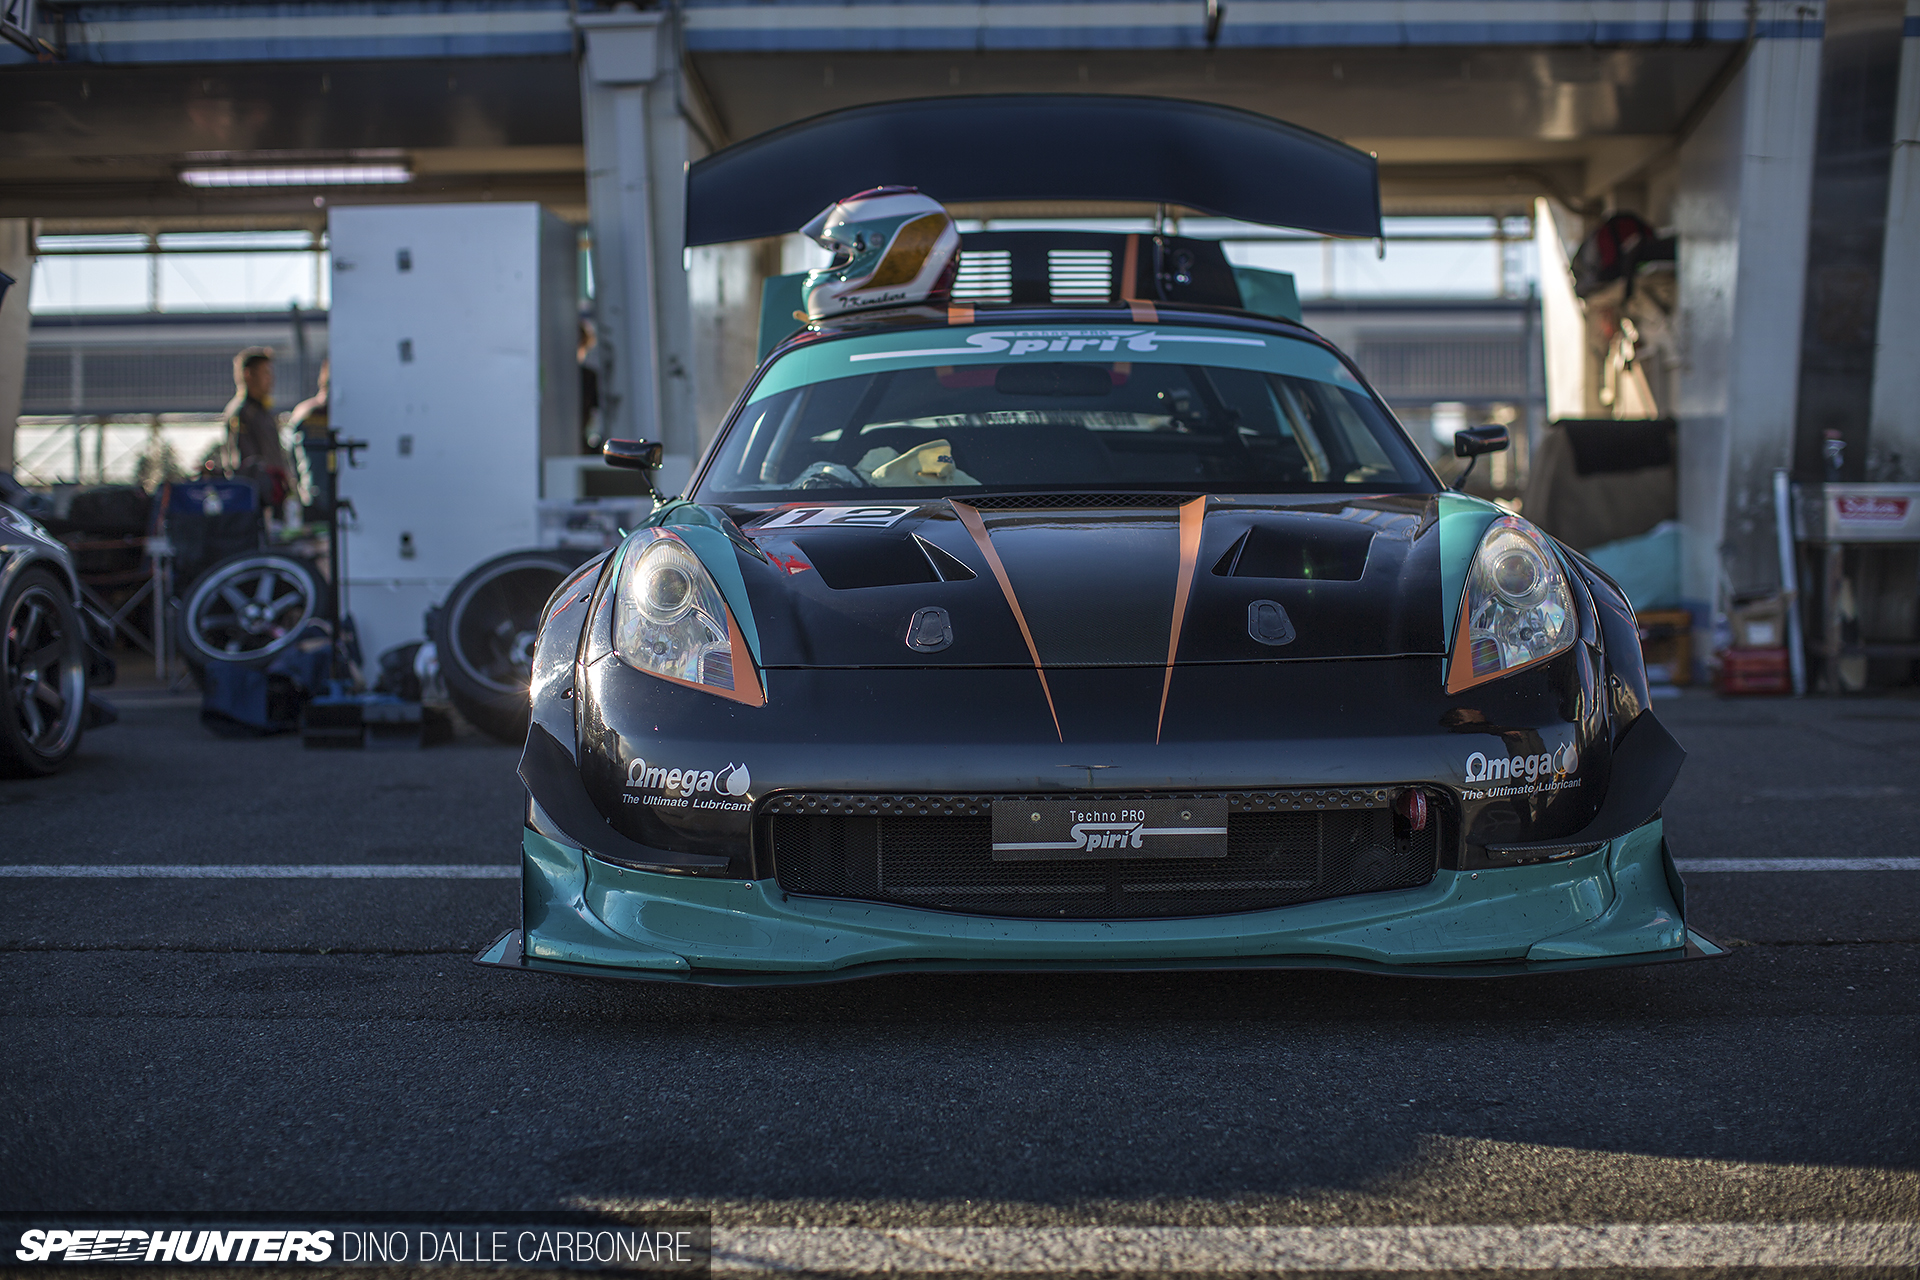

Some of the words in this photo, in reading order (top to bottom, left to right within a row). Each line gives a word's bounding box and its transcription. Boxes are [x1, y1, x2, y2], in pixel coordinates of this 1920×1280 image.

[966, 330, 1159, 356] Spirit
[785, 507, 907, 526] 12
[1461, 790, 1484, 801] The
[1487, 783, 1536, 798] Ultimate
[1538, 777, 1582, 792] Lubricant
[622, 793, 640, 805] The
[642, 795, 689, 808] Ultimate
[692, 798, 753, 812] Lubricant
[1069, 810, 1117, 822] Techno
[1121, 809, 1145, 821] PRO
[1070, 822, 1144, 852] Spirit
